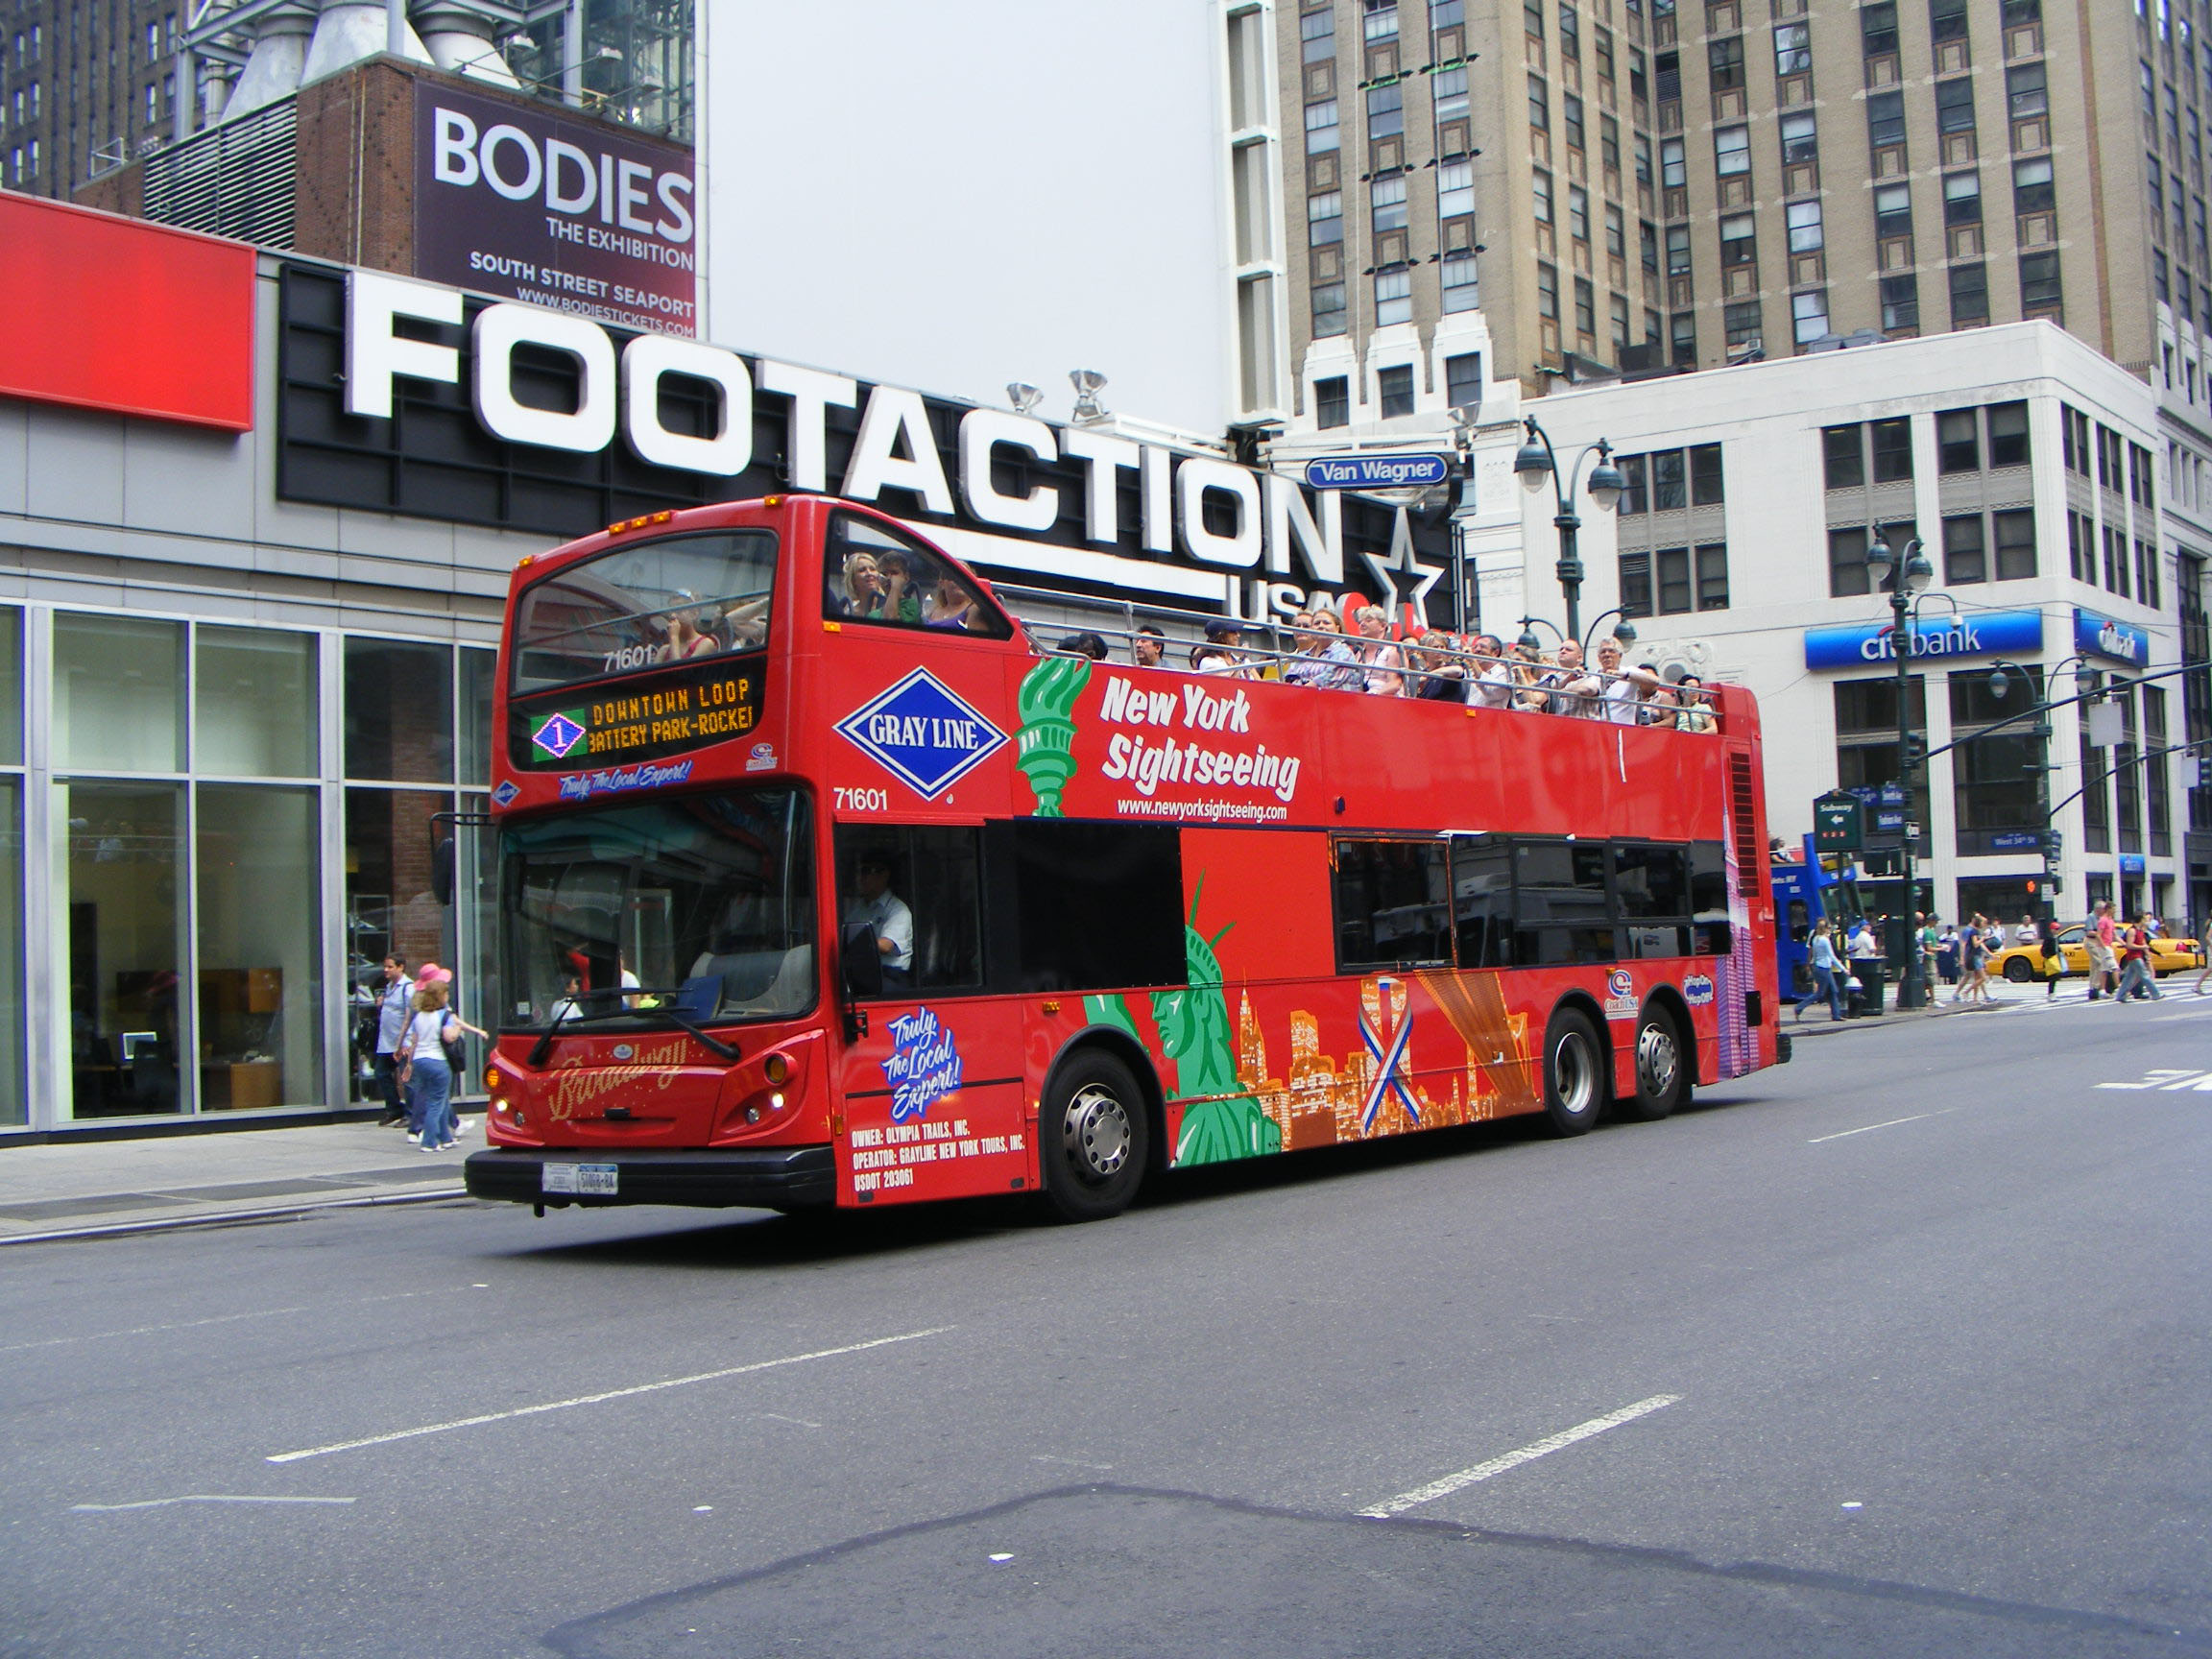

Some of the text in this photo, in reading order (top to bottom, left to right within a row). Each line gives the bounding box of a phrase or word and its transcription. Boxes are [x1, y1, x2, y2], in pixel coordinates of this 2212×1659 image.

[434, 107, 694, 244] BODIES
[545, 216, 694, 273] THE EXHIBITION
[469, 251, 694, 319] SOUTH STREET SEAPORT
[517, 286, 694, 337] WWW.BODIESTICKETS.COM
[344, 271, 1343, 584] FOOTACTION
[1319, 461, 1437, 483] Van Wagner
[603, 643, 653, 673] 71601
[1860, 621, 1983, 661] citbank
[591, 678, 750, 727] DOWNTOWN LOOP
[1099, 675, 1251, 733] New York
[552, 721, 567, 750] 1
[868, 713, 979, 751] GRAY LINE
[609, 765, 642, 790] Local
[638, 759, 693, 787] Expert!
[1101, 733, 1302, 803] Sightseeing
[832, 786, 889, 811] 71601
[1117, 797, 1288, 824] www.newyorksightseeing.com
[1819, 804, 1853, 812] Subway
[880, 1028, 954, 1083] The Local
[891, 1055, 961, 1120] Expert!
[852, 1118, 971, 1148] OWNER: OLYMPIA TRAILS, INC.
[853, 1134, 1025, 1170] OPERATOR: GRAYLINE NEW YORK TOURS, INC.
[854, 1167, 914, 1192] USDOT 203061
